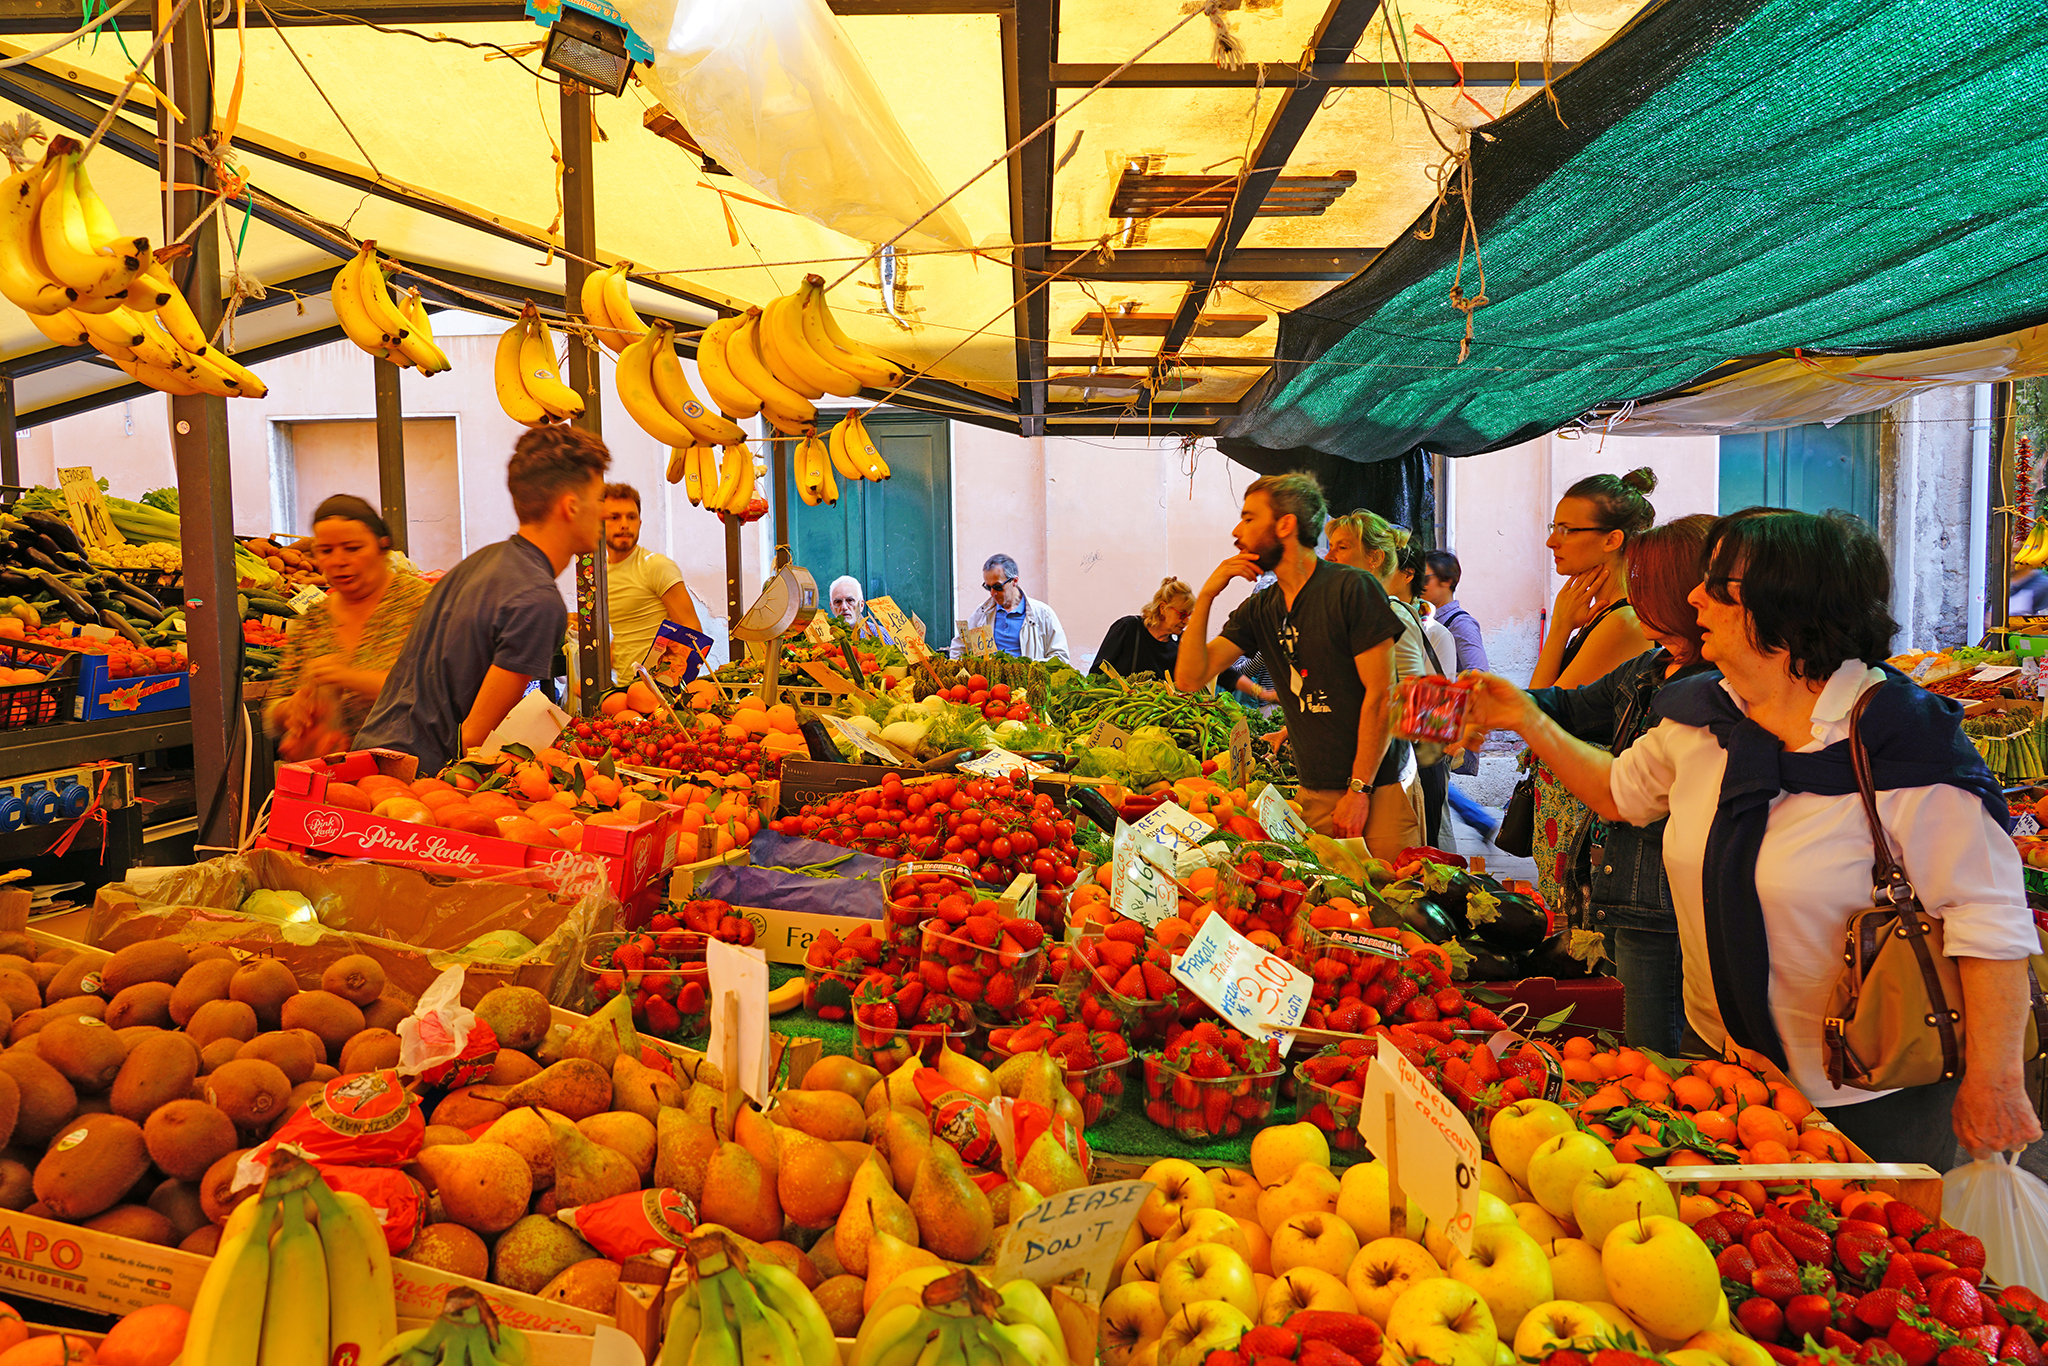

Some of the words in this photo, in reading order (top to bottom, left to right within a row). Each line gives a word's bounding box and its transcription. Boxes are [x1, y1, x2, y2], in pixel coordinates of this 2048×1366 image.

[308, 818, 334, 832] Pink
[313, 827, 338, 838] Lady
[351, 825, 420, 853] Pink
[419, 836, 484, 874] Lady
[1113, 853, 1126, 910] TAROCCO
[1177, 935, 1218, 979] FRAGOLE
[1017, 1185, 1143, 1231] PLEASE
[1023, 1220, 1113, 1264] DON'T
[0, 1264, 87, 1294] ALIGERA
[106, 1278, 130, 1290] ITALIA
